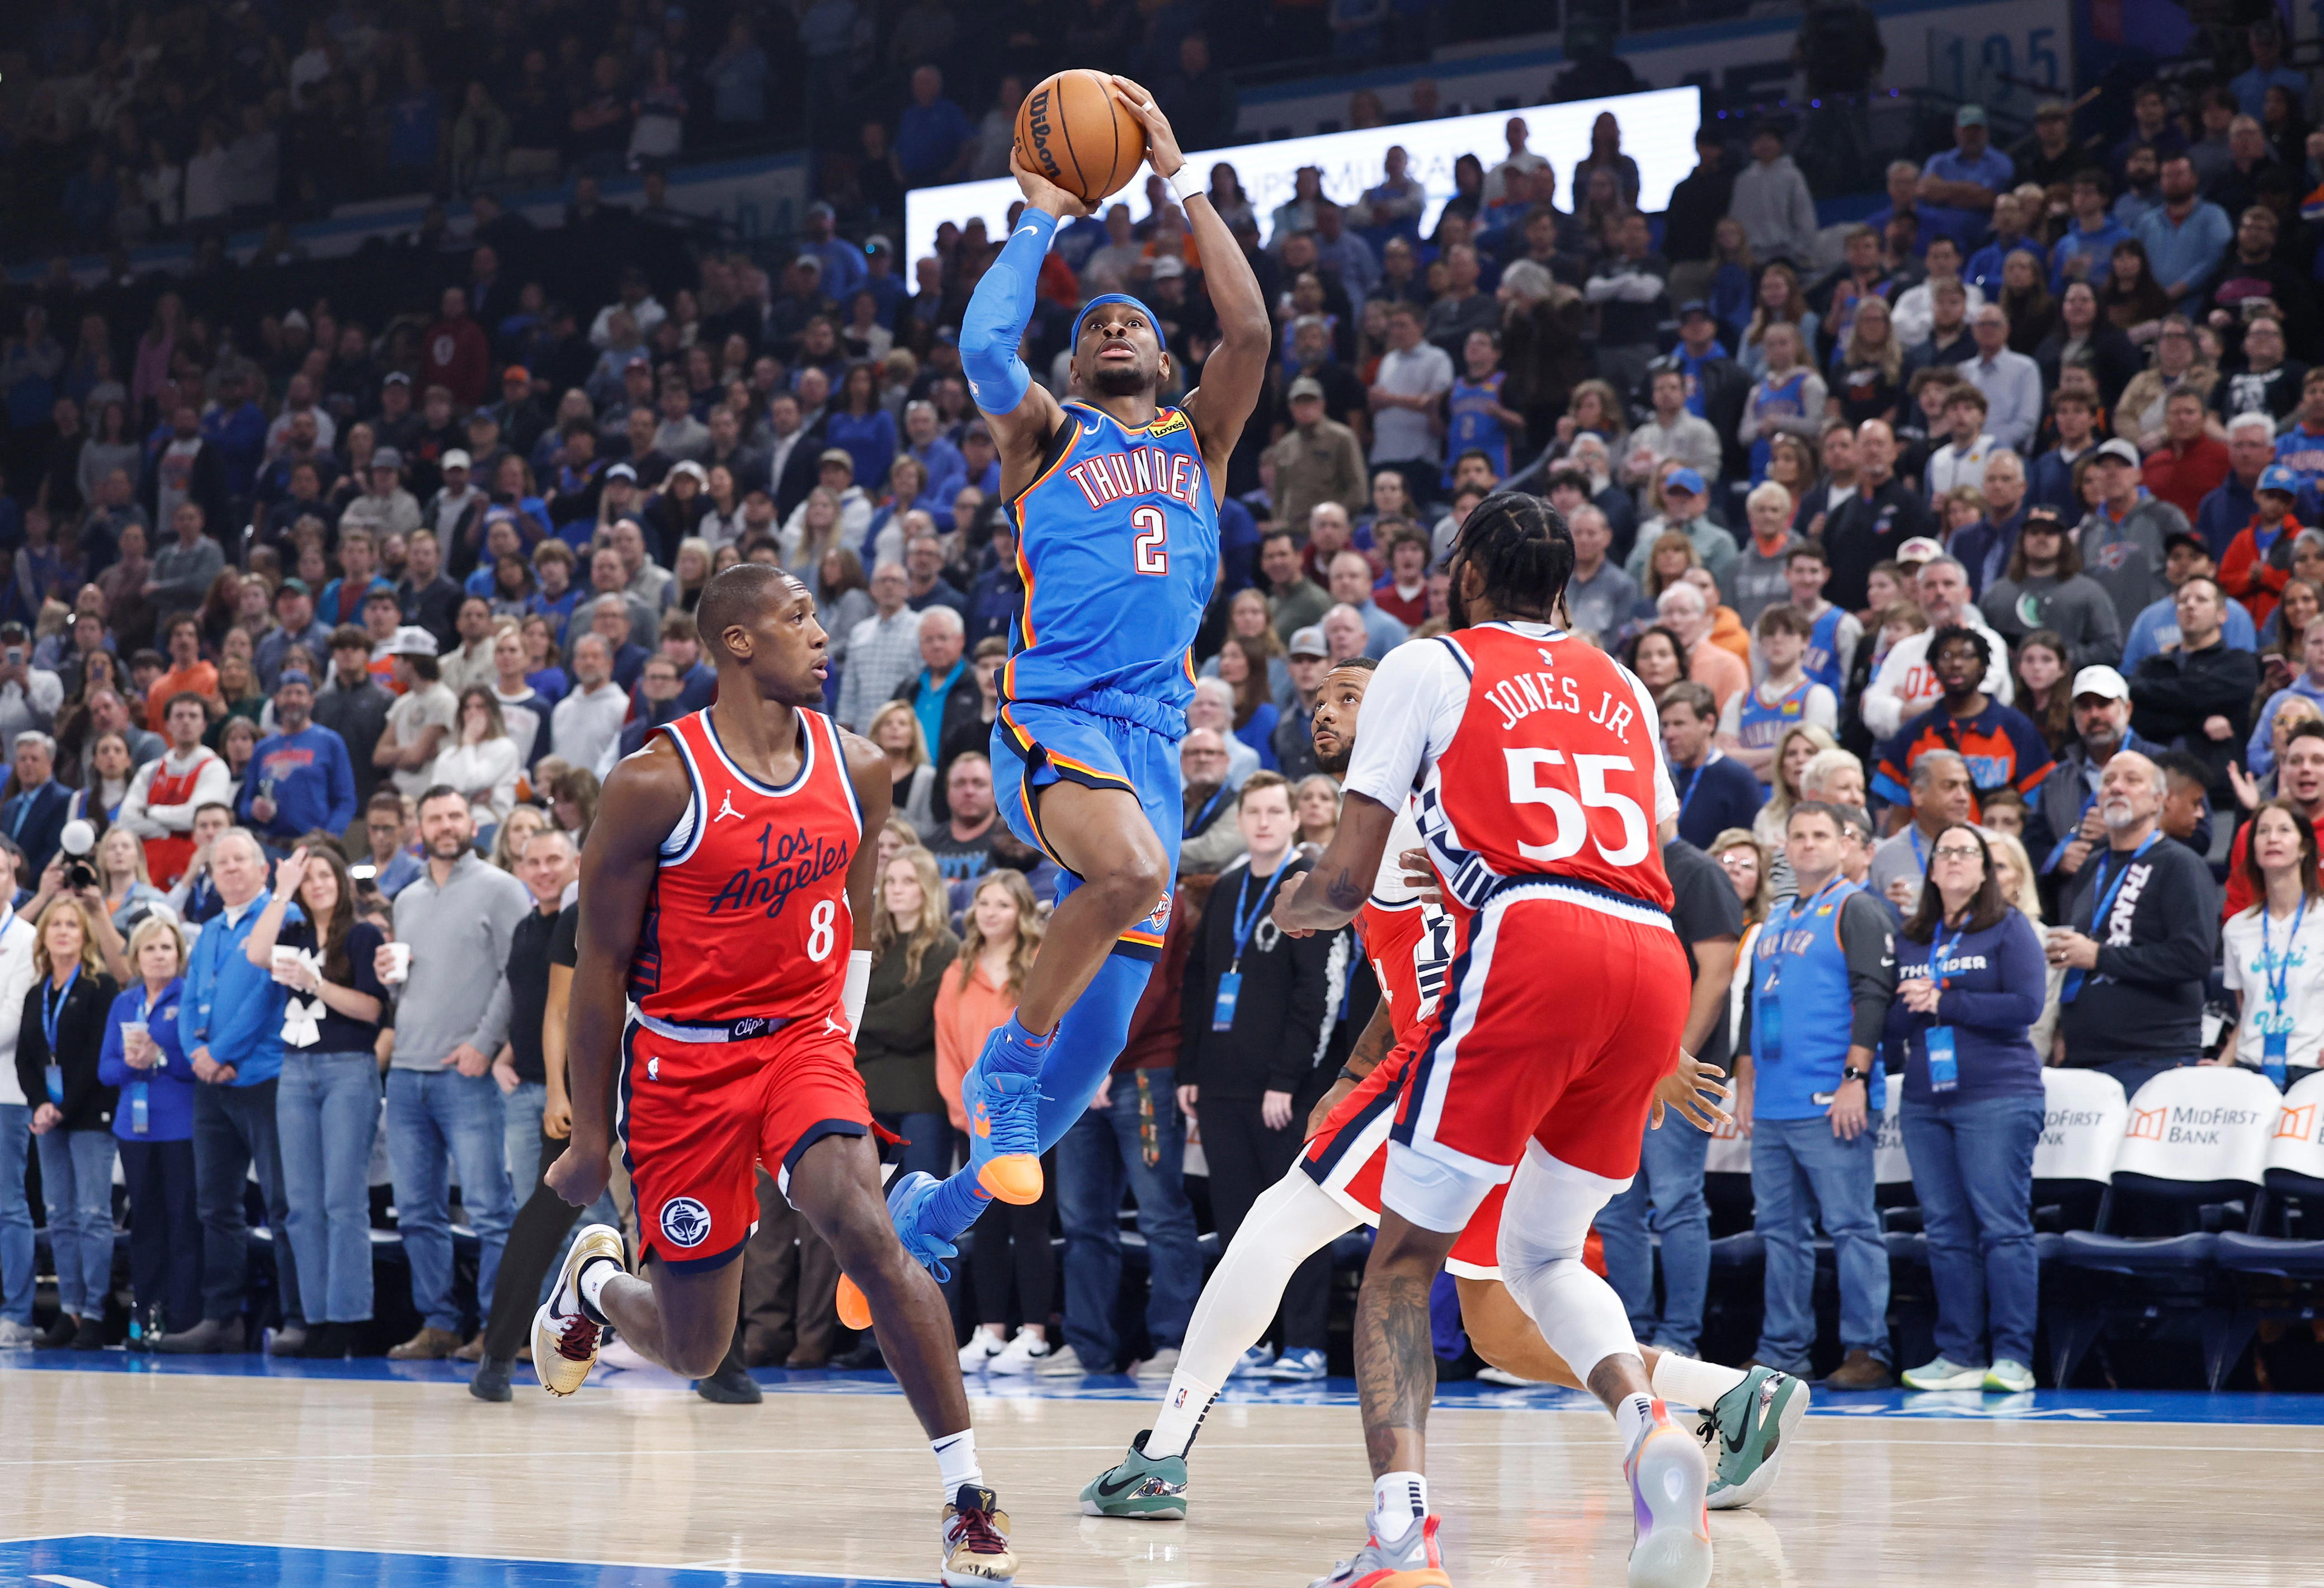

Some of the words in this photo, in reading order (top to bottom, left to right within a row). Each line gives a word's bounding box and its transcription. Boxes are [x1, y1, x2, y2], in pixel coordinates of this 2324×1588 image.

[1029, 88, 1062, 179] Wilson
[1065, 445, 1202, 511] THUNDER
[1131, 504, 1169, 576] 2
[1484, 672, 1580, 730] JONES
[1588, 691, 1634, 744] JR.
[1502, 747, 1649, 867] 55
[708, 837, 848, 918] Angeles
[757, 823, 813, 872] Los
[807, 900, 836, 962] 8
[2106, 863, 2153, 947] THUNDE
[734, 1018, 765, 1036] Clips
[2040, 1131, 2065, 1145] NK
[2047, 1109, 2104, 1127] DFIRST
